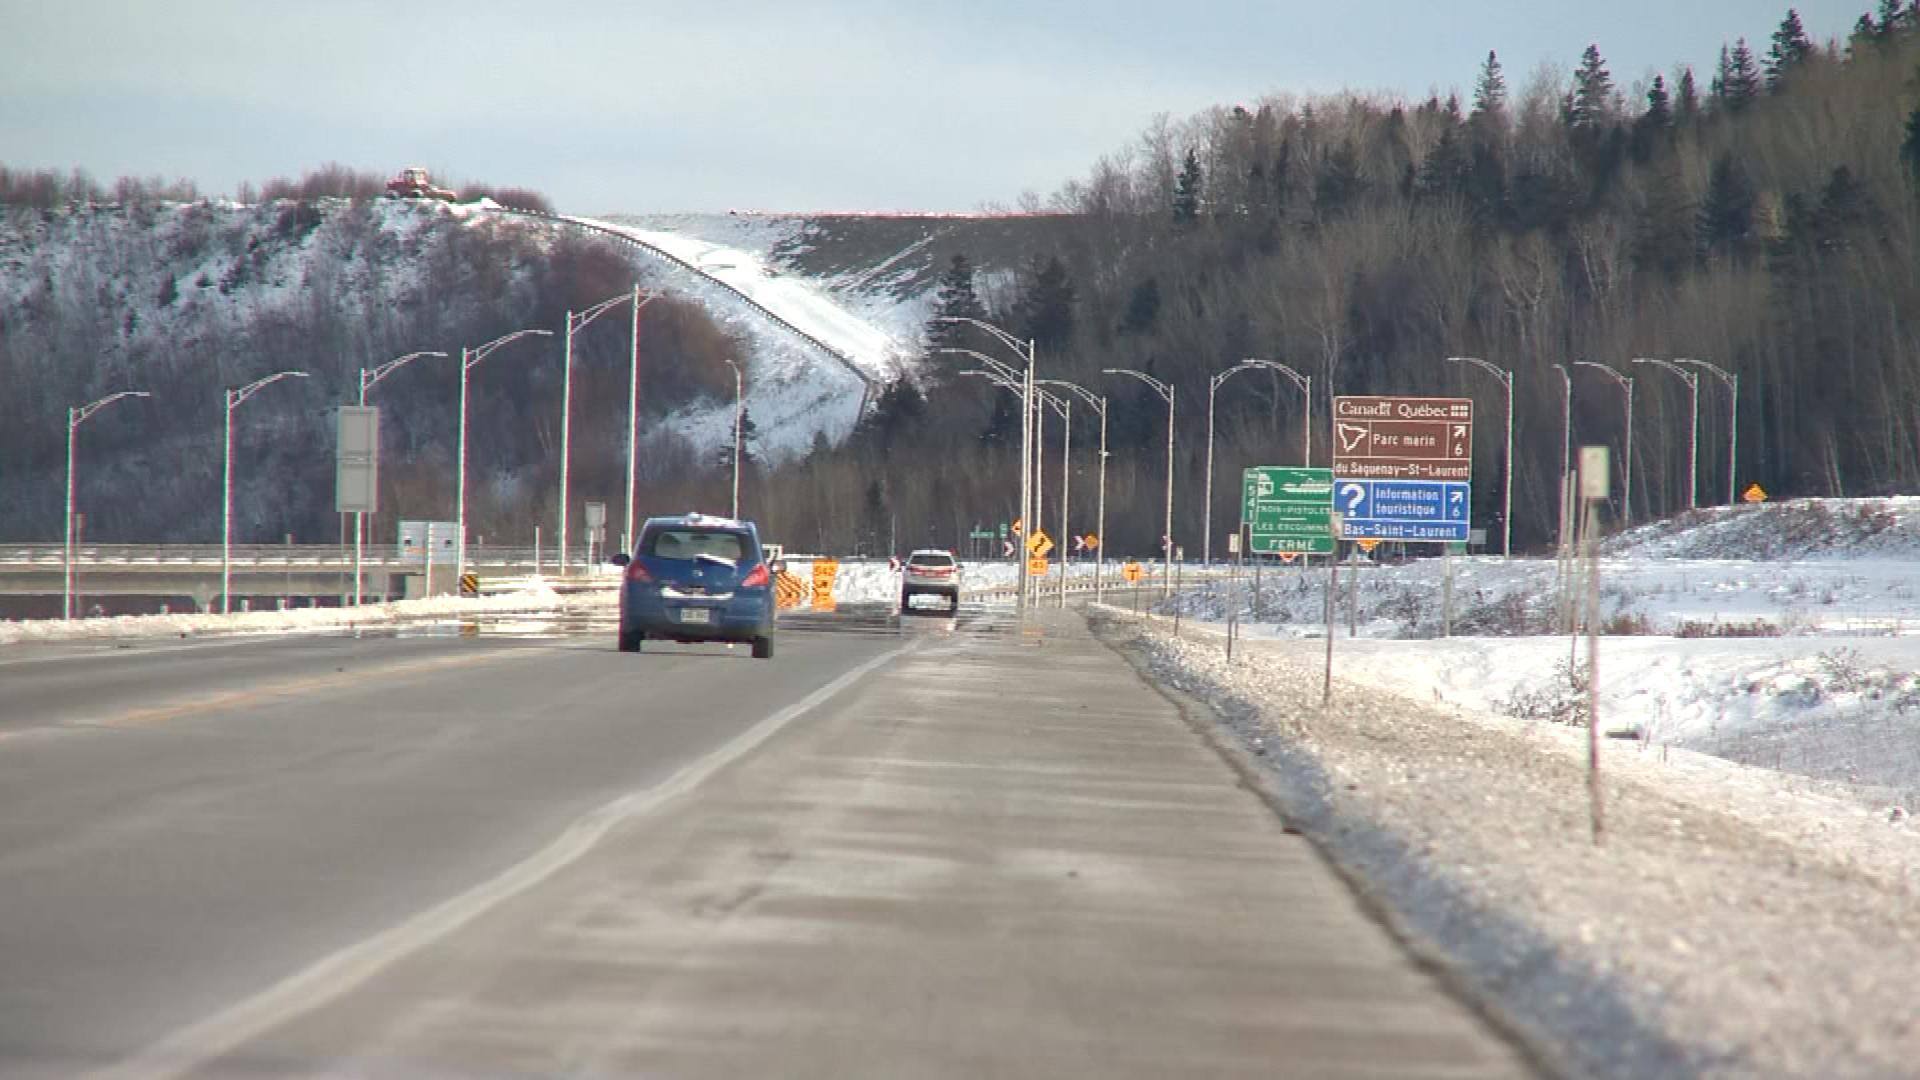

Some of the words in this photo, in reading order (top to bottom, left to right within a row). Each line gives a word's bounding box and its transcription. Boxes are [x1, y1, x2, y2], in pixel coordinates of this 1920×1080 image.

[1398, 404, 1448, 418] Québec
[1373, 433, 1398, 445] Parc
[1403, 434, 1436, 447] marin
[1455, 443, 1463, 456] 6
[1335, 463, 1348, 473] du
[1375, 488, 1439, 501] Information
[1375, 504, 1436, 517] touristique
[1453, 506, 1461, 517] 6
[1344, 523, 1457, 538] Bas-Saint-Laurent
[1269, 538, 1317, 551] FERMÉ
